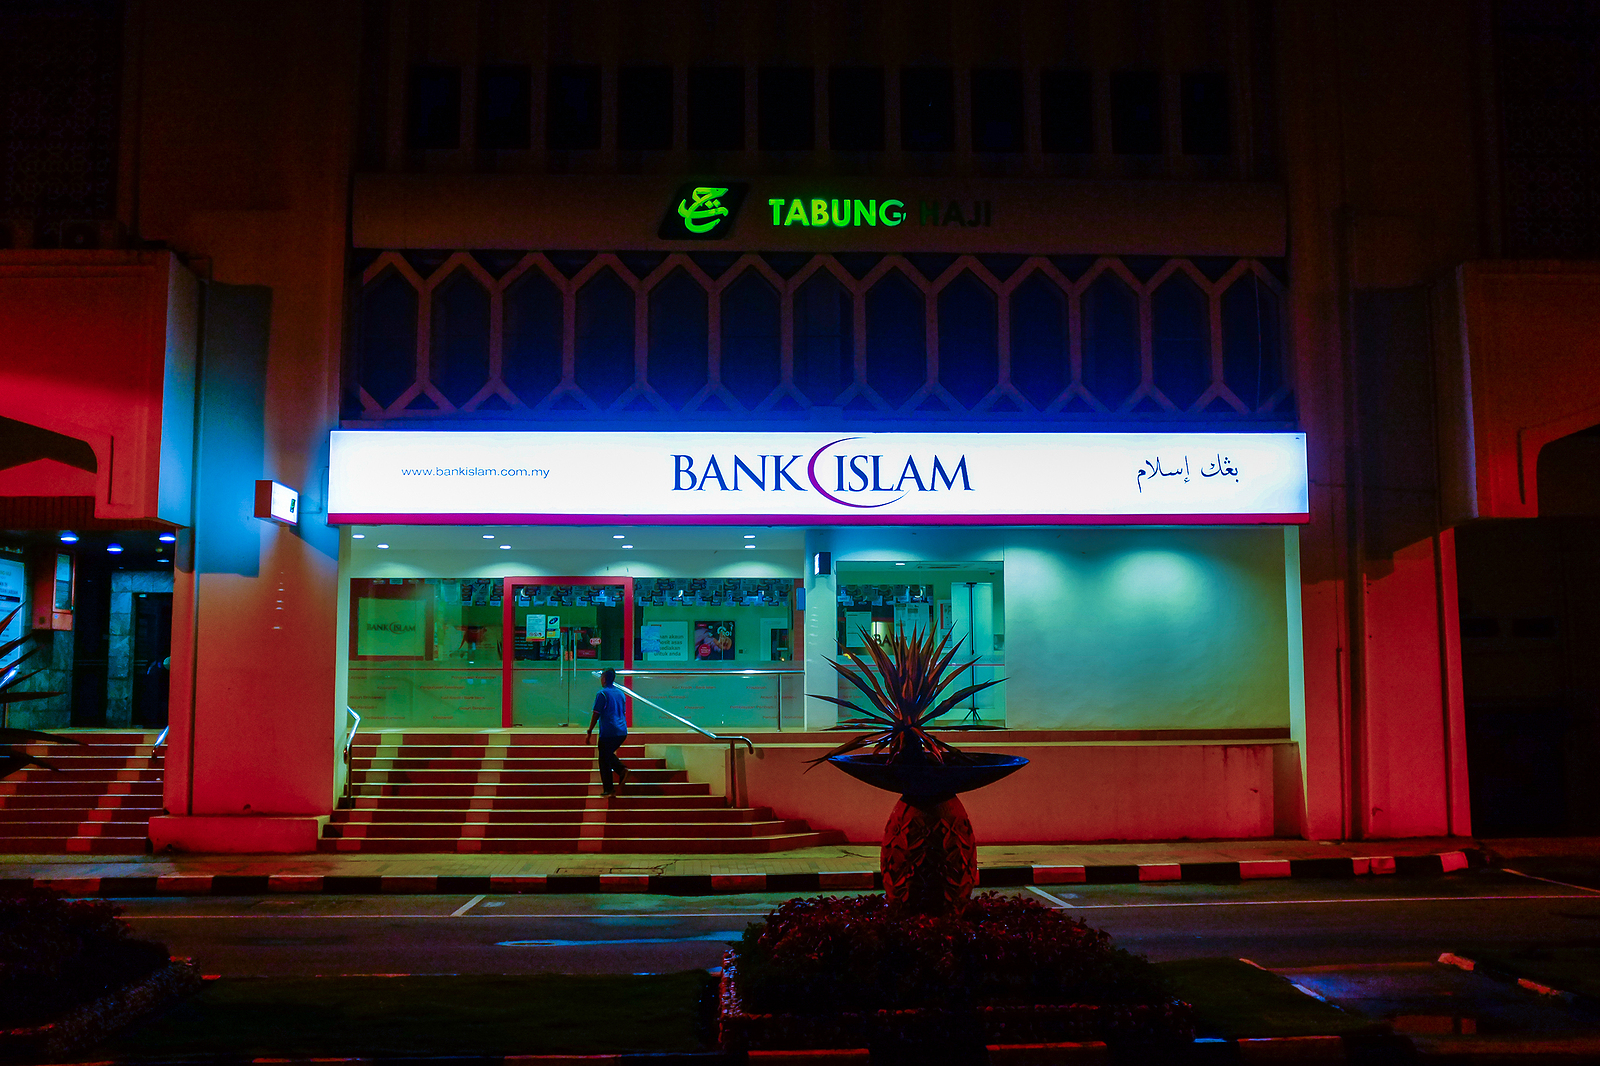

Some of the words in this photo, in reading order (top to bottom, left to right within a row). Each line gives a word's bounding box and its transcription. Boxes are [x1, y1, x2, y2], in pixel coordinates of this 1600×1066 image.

[768, 198, 907, 228] TABUNG
[919, 199, 992, 227] HAJI
[401, 466, 550, 479] www.bankislam.com.my
[670, 454, 808, 492] BANK
[833, 454, 975, 492] ISLAM
[367, 623, 389, 632] BANK
[393, 624, 416, 632] ISLAM
